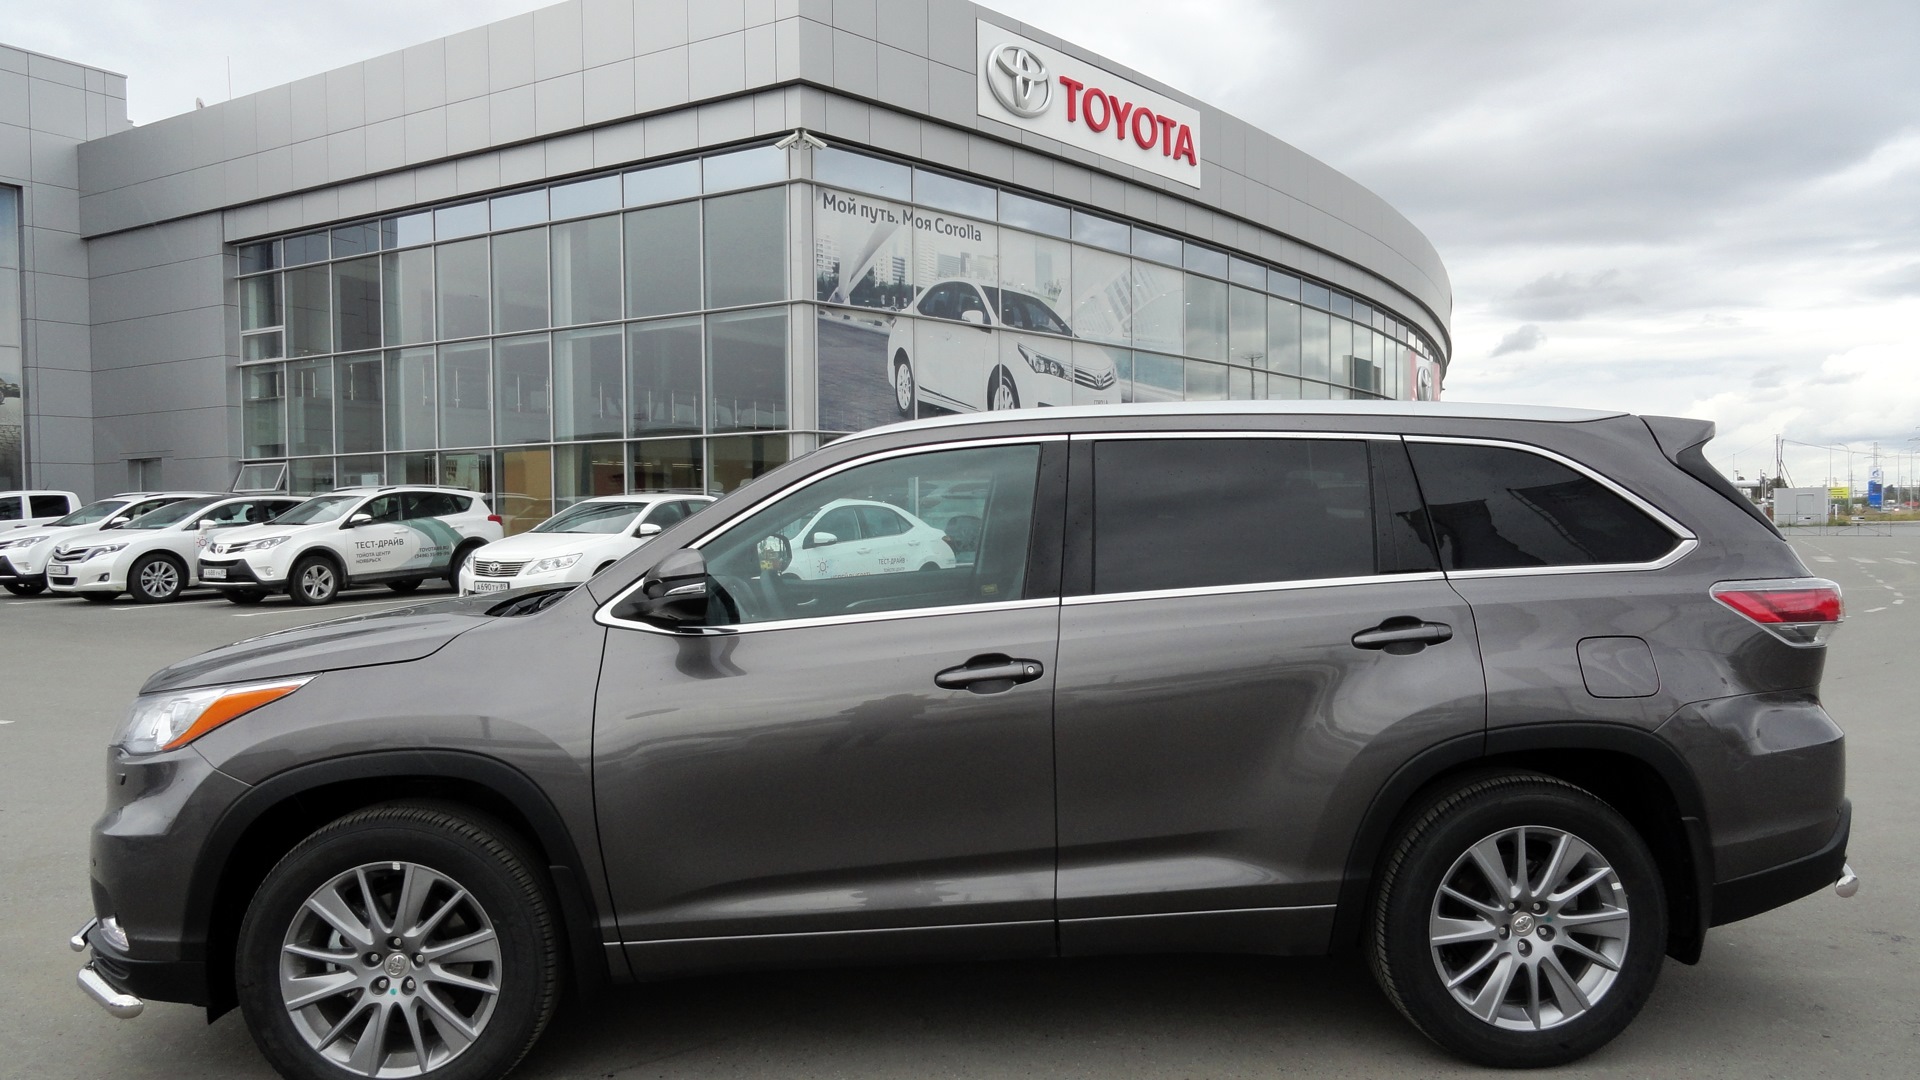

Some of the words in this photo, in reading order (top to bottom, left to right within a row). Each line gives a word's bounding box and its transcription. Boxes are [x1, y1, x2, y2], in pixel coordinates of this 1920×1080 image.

[1059, 75, 1197, 167] TOYOTA
[823, 192, 856, 216] Мой
[860, 204, 899, 224] путь.
[902, 209, 931, 231] Моя
[934, 217, 982, 242] Corolla
[355, 536, 404, 549] ТЕСТ-ДРАЙВ
